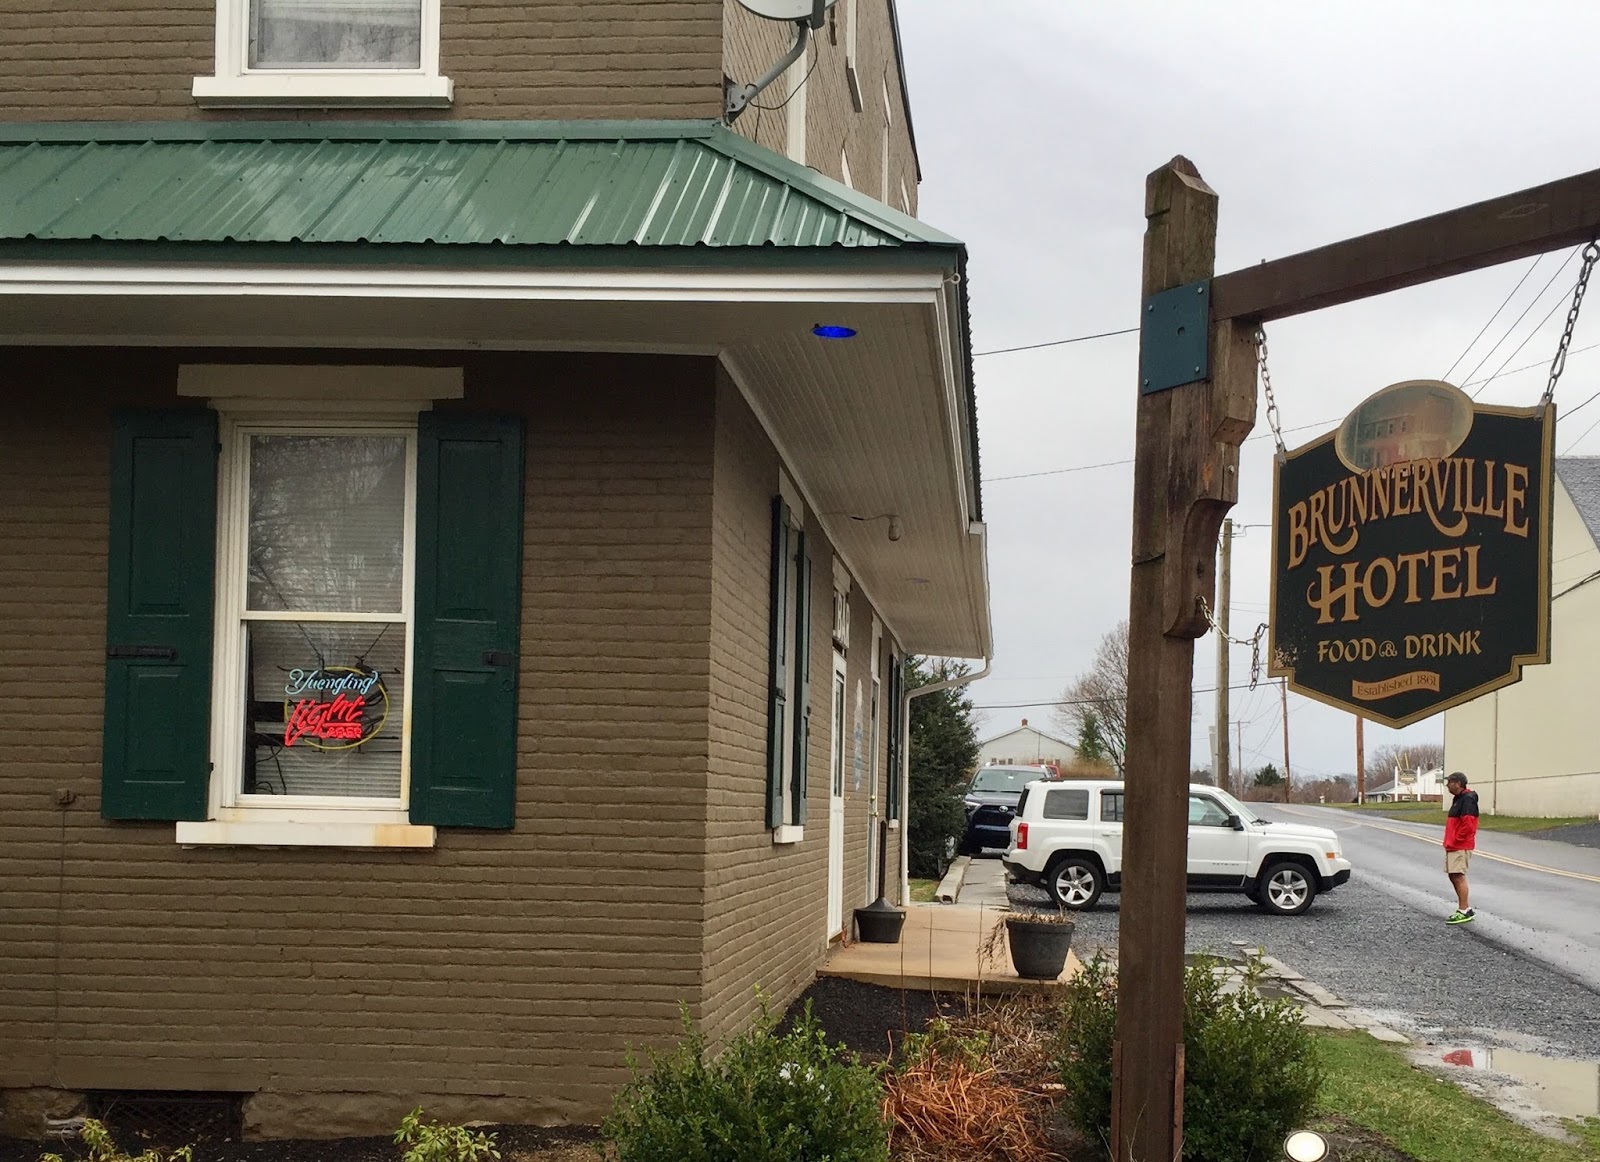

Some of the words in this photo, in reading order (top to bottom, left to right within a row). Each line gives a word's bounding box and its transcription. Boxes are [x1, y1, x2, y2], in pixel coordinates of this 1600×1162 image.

[1287, 457, 1530, 570] BRUNNERVILLE
[1306, 545, 1497, 625] HOTEL
[1317, 638, 1377, 663] FOOD
[1379, 640, 1398, 658] &
[1403, 630, 1483, 659] DRINK
[285, 668, 379, 695] Yuengling
[1357, 675, 1413, 696] Established
[1416, 674, 1436, 686] 1861
